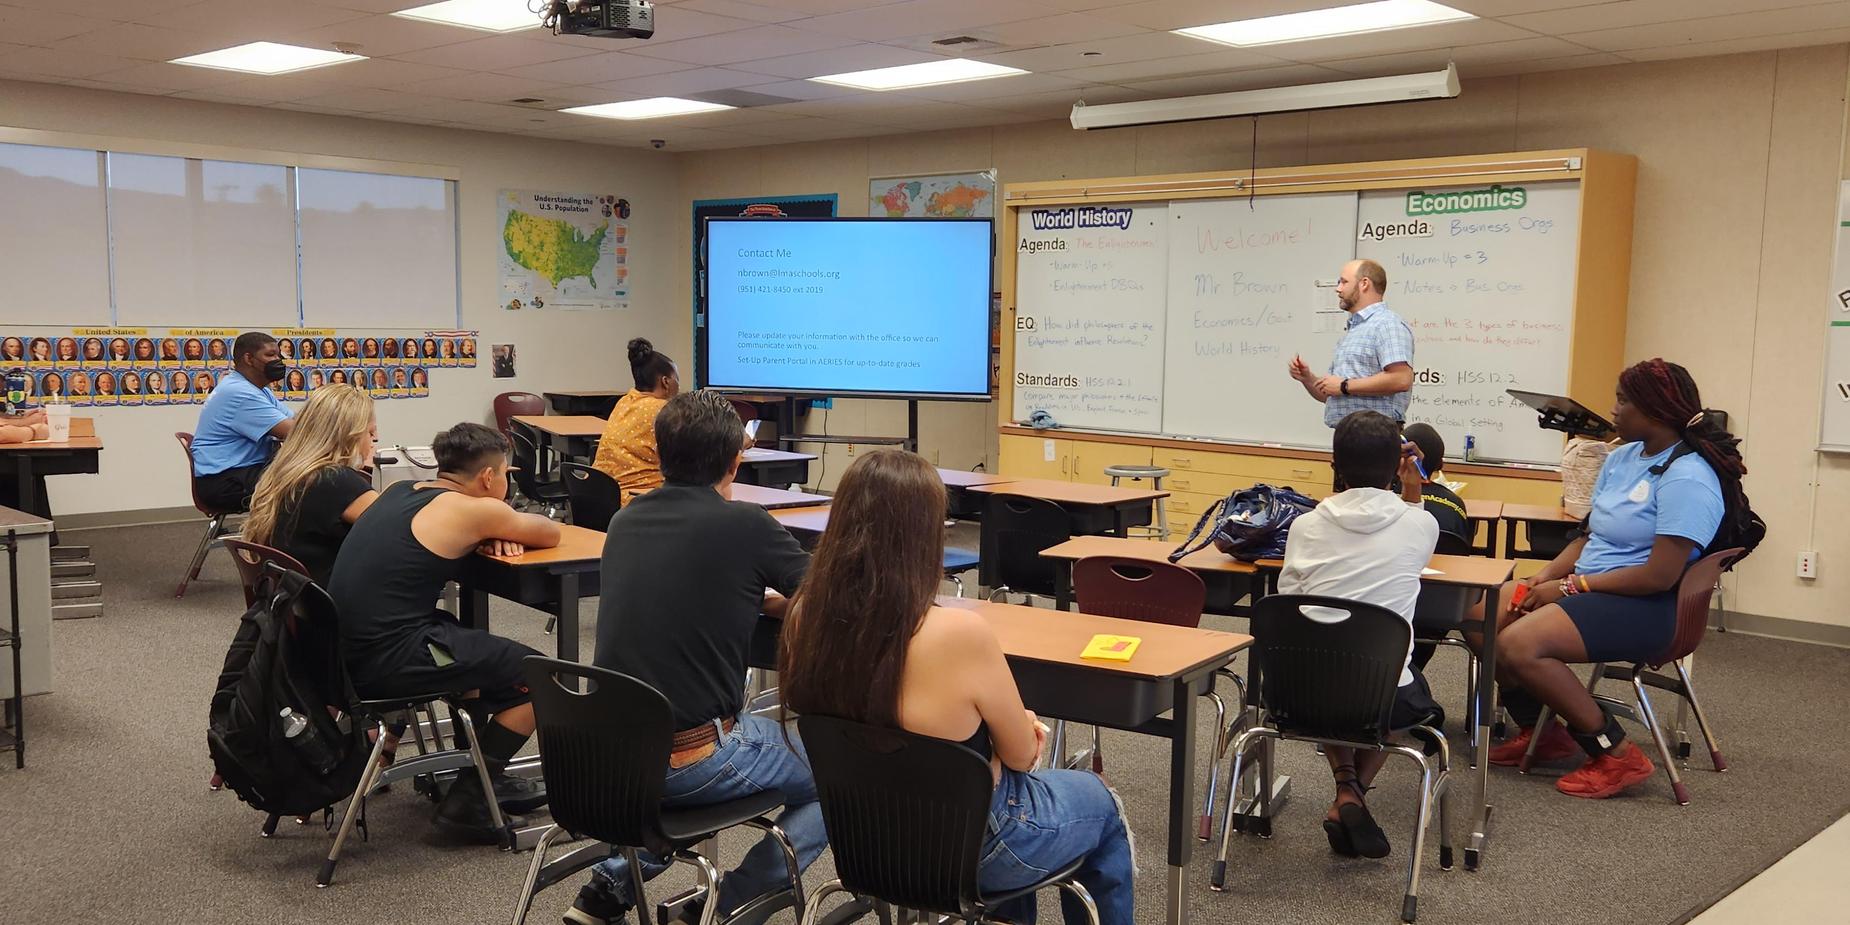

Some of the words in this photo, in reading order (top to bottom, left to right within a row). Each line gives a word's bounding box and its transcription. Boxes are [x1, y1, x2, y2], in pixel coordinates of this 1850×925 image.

[534, 195, 582, 205] Understanding
[583, 197, 594, 205] the
[1407, 188, 1526, 214] Economics
[555, 205, 588, 213] Population
[1033, 210, 1074, 228] World
[1079, 209, 1132, 229] History
[1362, 220, 1433, 240] Agenda:
[1450, 218, 1511, 236] Business
[738, 248, 774, 258] Contact
[776, 249, 792, 258] Me
[738, 268, 840, 279] nbrown@lmaschools.org
[738, 284, 756, 294] (951)
[758, 285, 791, 294] 421-8450
[793, 286, 804, 294] ext
[806, 286, 825, 294] 2019
[1195, 273, 1221, 297] Mr
[1232, 271, 1288, 297] Brown
[85, 328, 112, 336] United
[113, 328, 138, 336] States
[738, 331, 761, 340] Please
[762, 332, 786, 342] update
[788, 333, 805, 342] your
[806, 332, 848, 342] information
[849, 333, 865, 341] with
[866, 333, 879, 341] the
[881, 334, 901, 342] office
[738, 341, 785, 349] communicate
[1194, 340, 1233, 357] World
[1240, 340, 1280, 359] History
[738, 356, 761, 365] Set-Up
[762, 357, 785, 365] Parent
[818, 358, 843, 366] AERIES
[844, 358, 855, 366] for
[857, 360, 895, 368] up-to-date
[897, 361, 921, 369] grades
[1016, 372, 1081, 388] Standards:
[1434, 394, 1482, 407] elements
